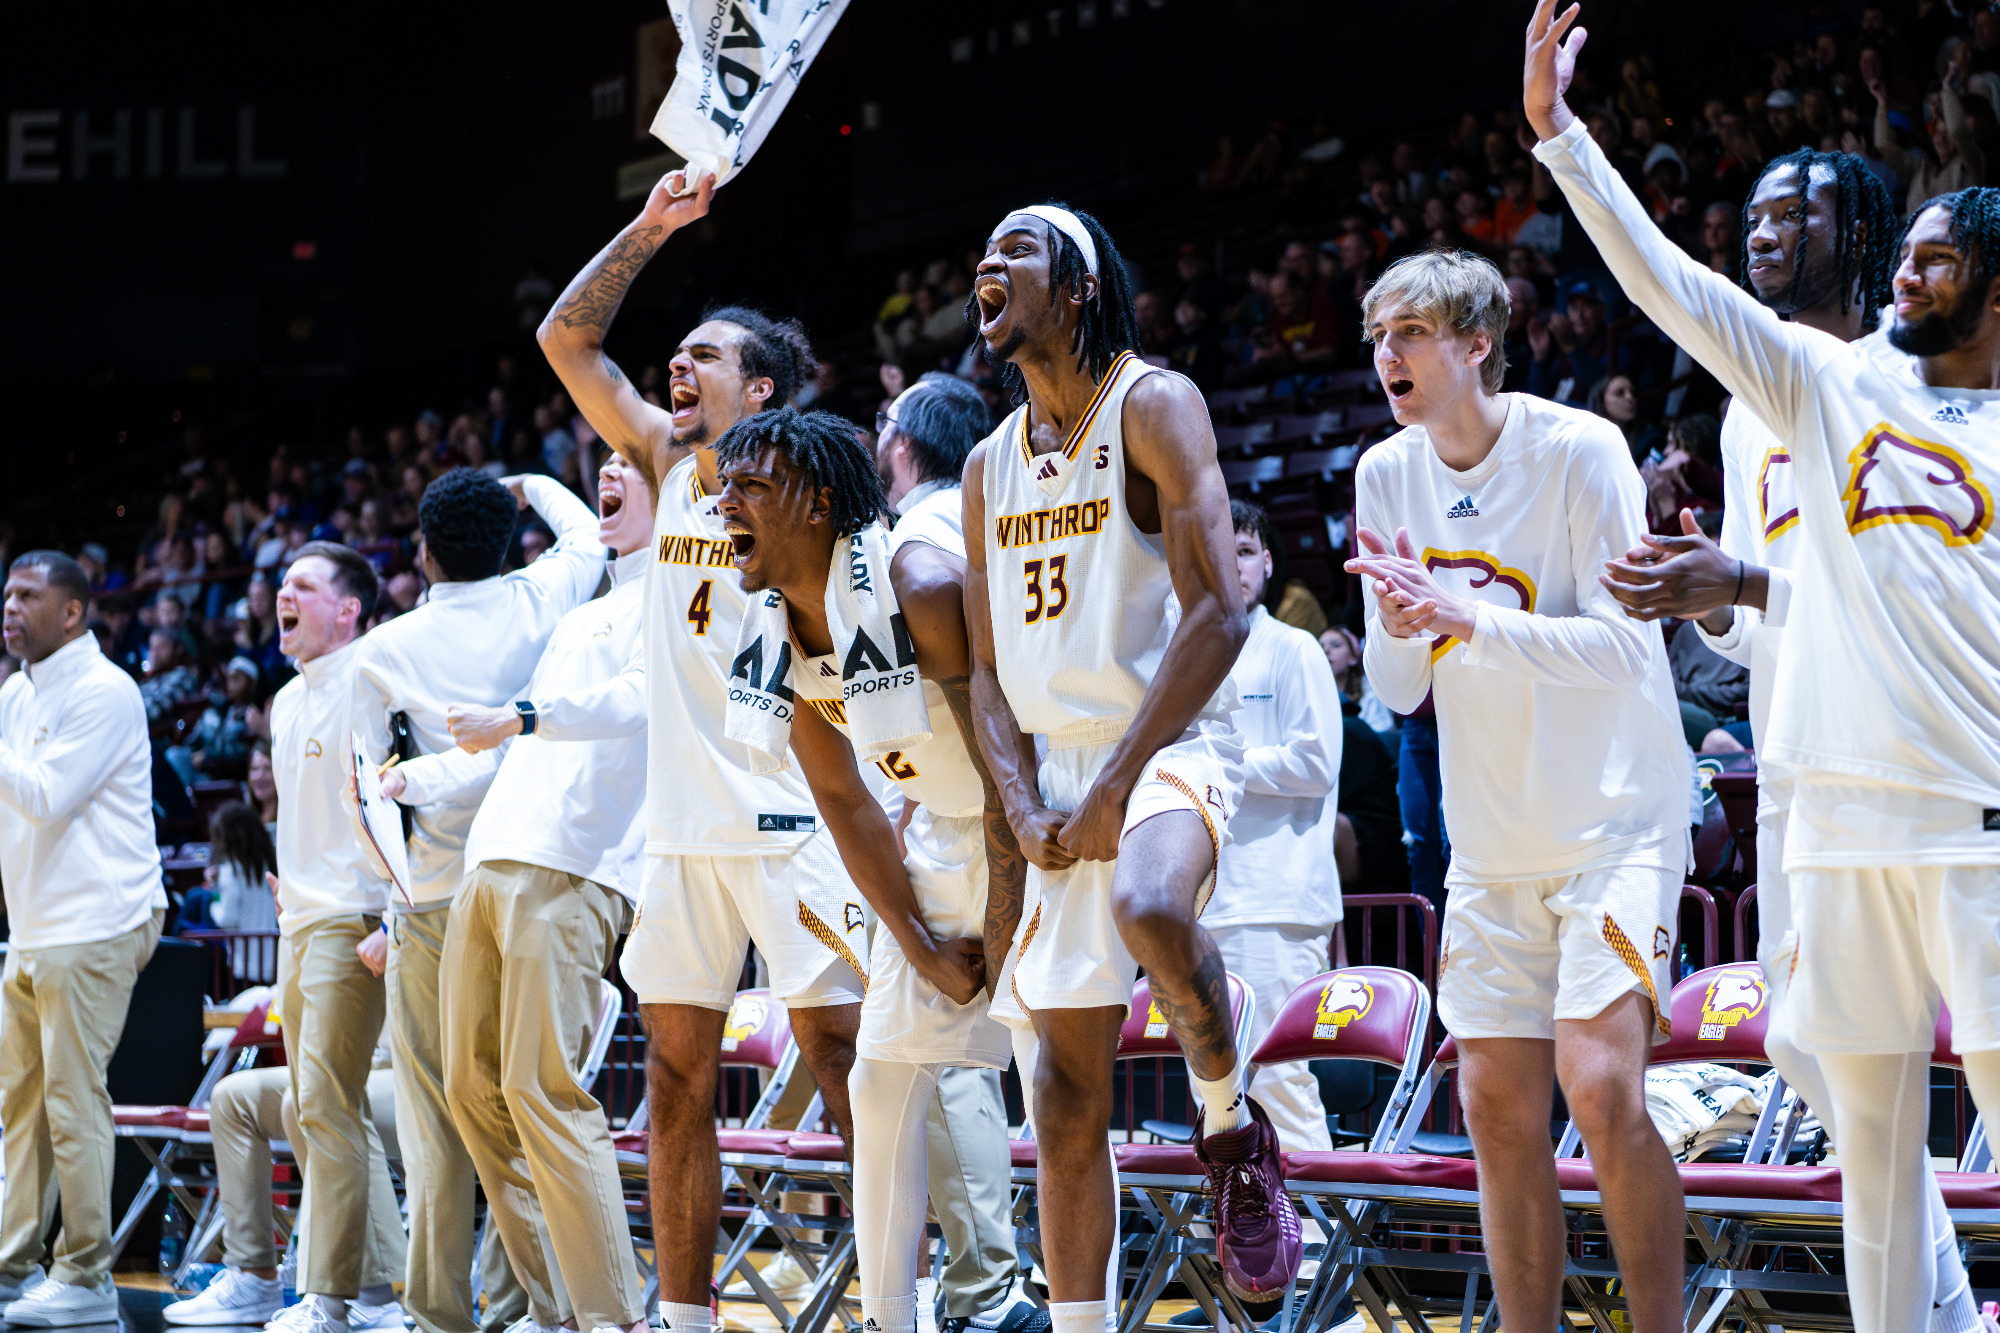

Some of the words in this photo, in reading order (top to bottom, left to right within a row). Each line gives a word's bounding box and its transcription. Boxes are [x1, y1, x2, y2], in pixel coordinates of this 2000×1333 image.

[996, 496, 1111, 550] WINTHROP
[1446, 509, 1480, 519] adidas
[687, 579, 714, 637] 4
[1024, 553, 1069, 625] 33
[843, 670, 915, 701] SPORTS
